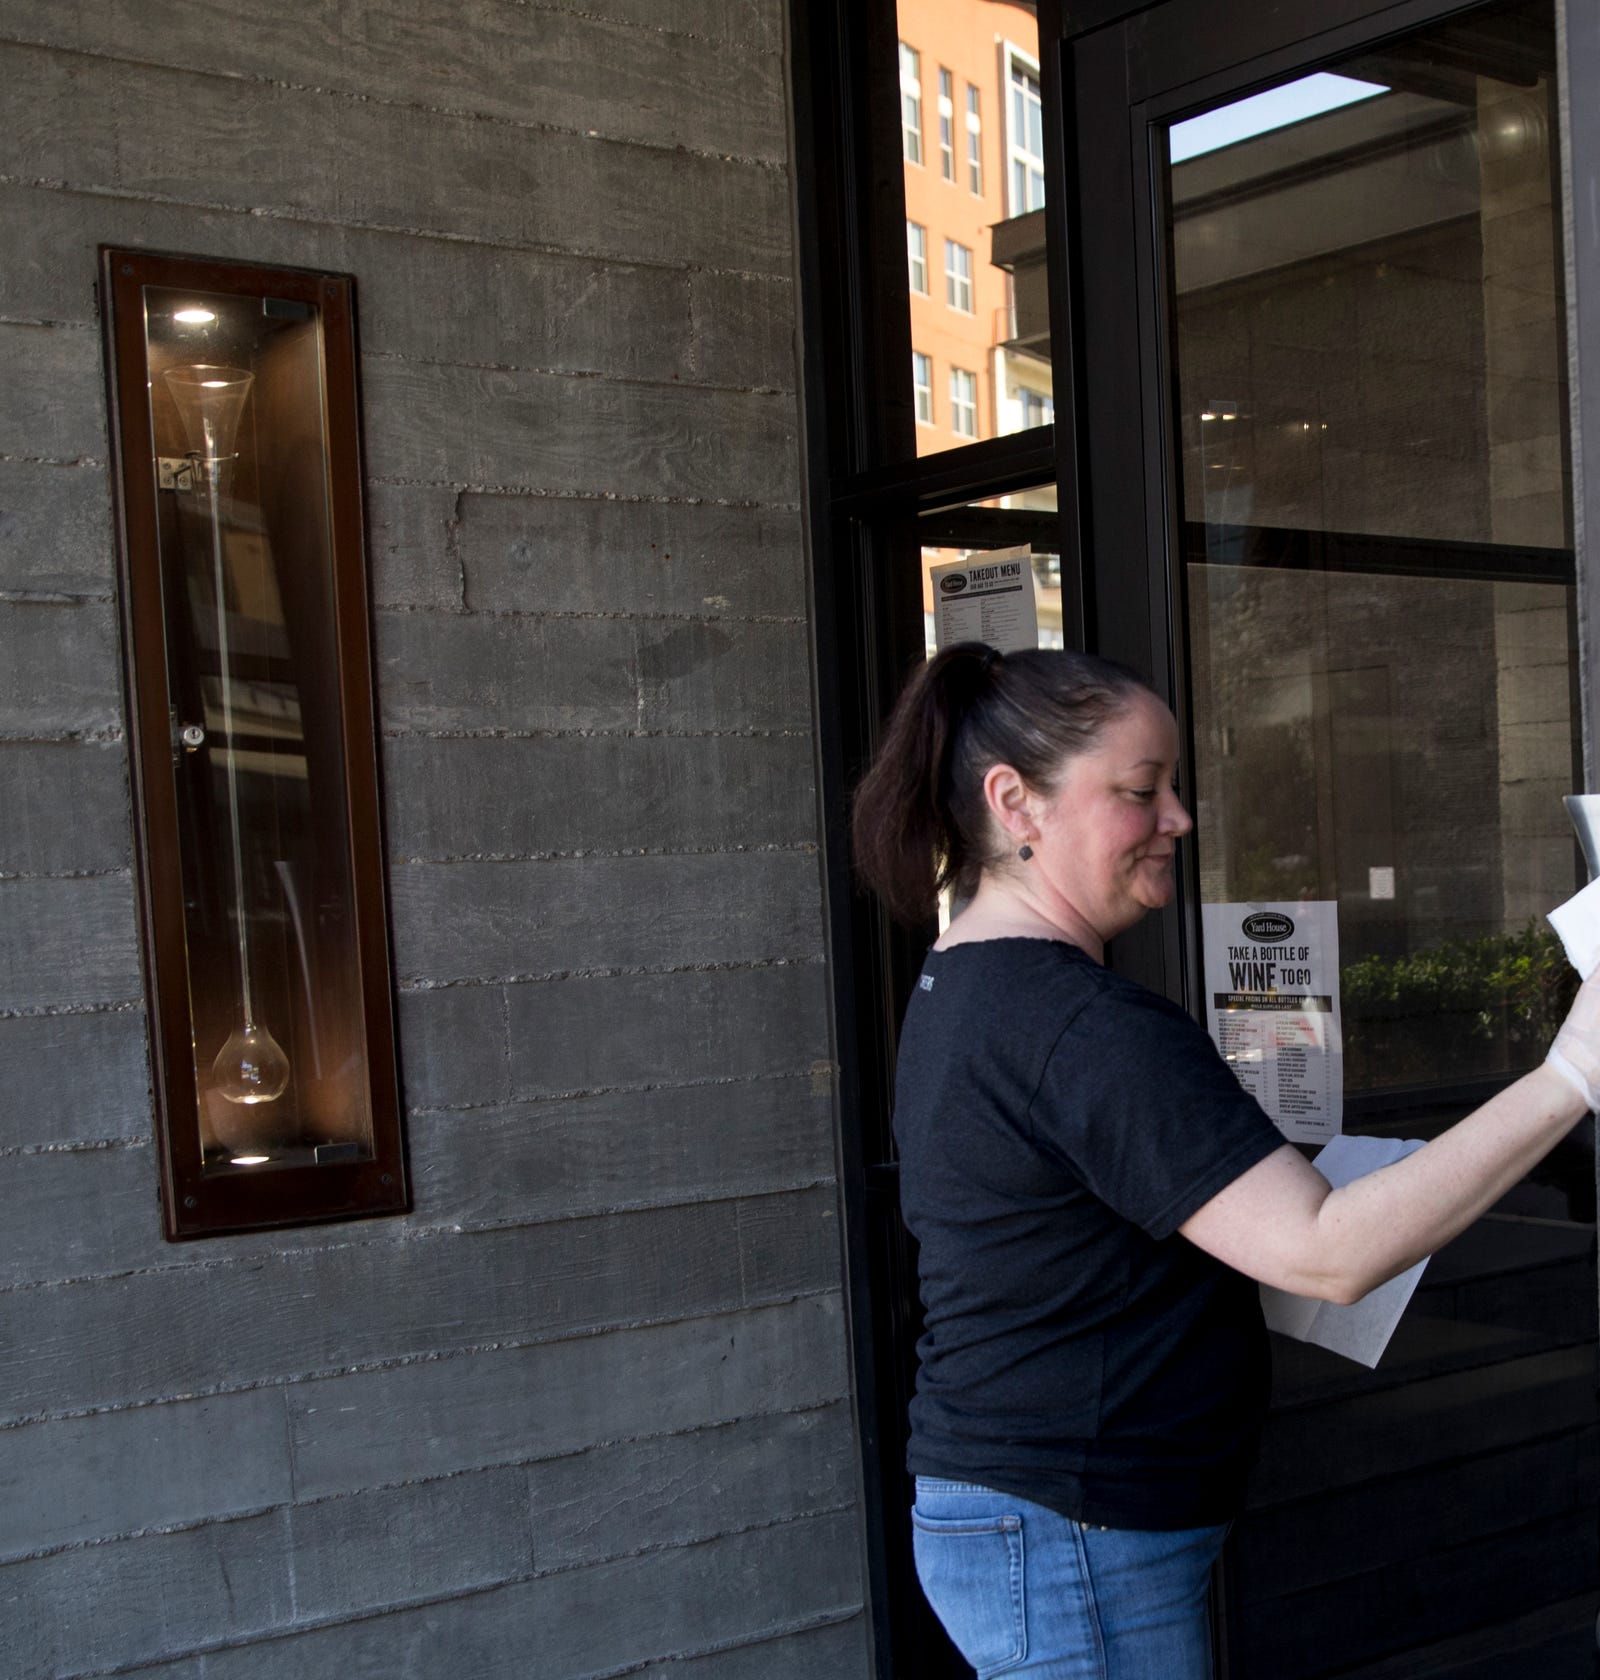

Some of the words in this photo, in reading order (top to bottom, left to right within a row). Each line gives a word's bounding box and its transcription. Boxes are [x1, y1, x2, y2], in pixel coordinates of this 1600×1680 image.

[969, 567, 998, 582] TAKEOUT
[1001, 562, 1020, 577] MENU
[1251, 921, 1265, 933] Yard
[1266, 922, 1287, 933] House
[1228, 946, 1250, 961] TAKE
[1252, 946, 1258, 961] A
[1260, 946, 1296, 961] BOTTLE
[1298, 946, 1310, 961] OF
[1229, 962, 1278, 992] WINE
[1280, 969, 1295, 985] TO
[1296, 969, 1311, 986] GO
